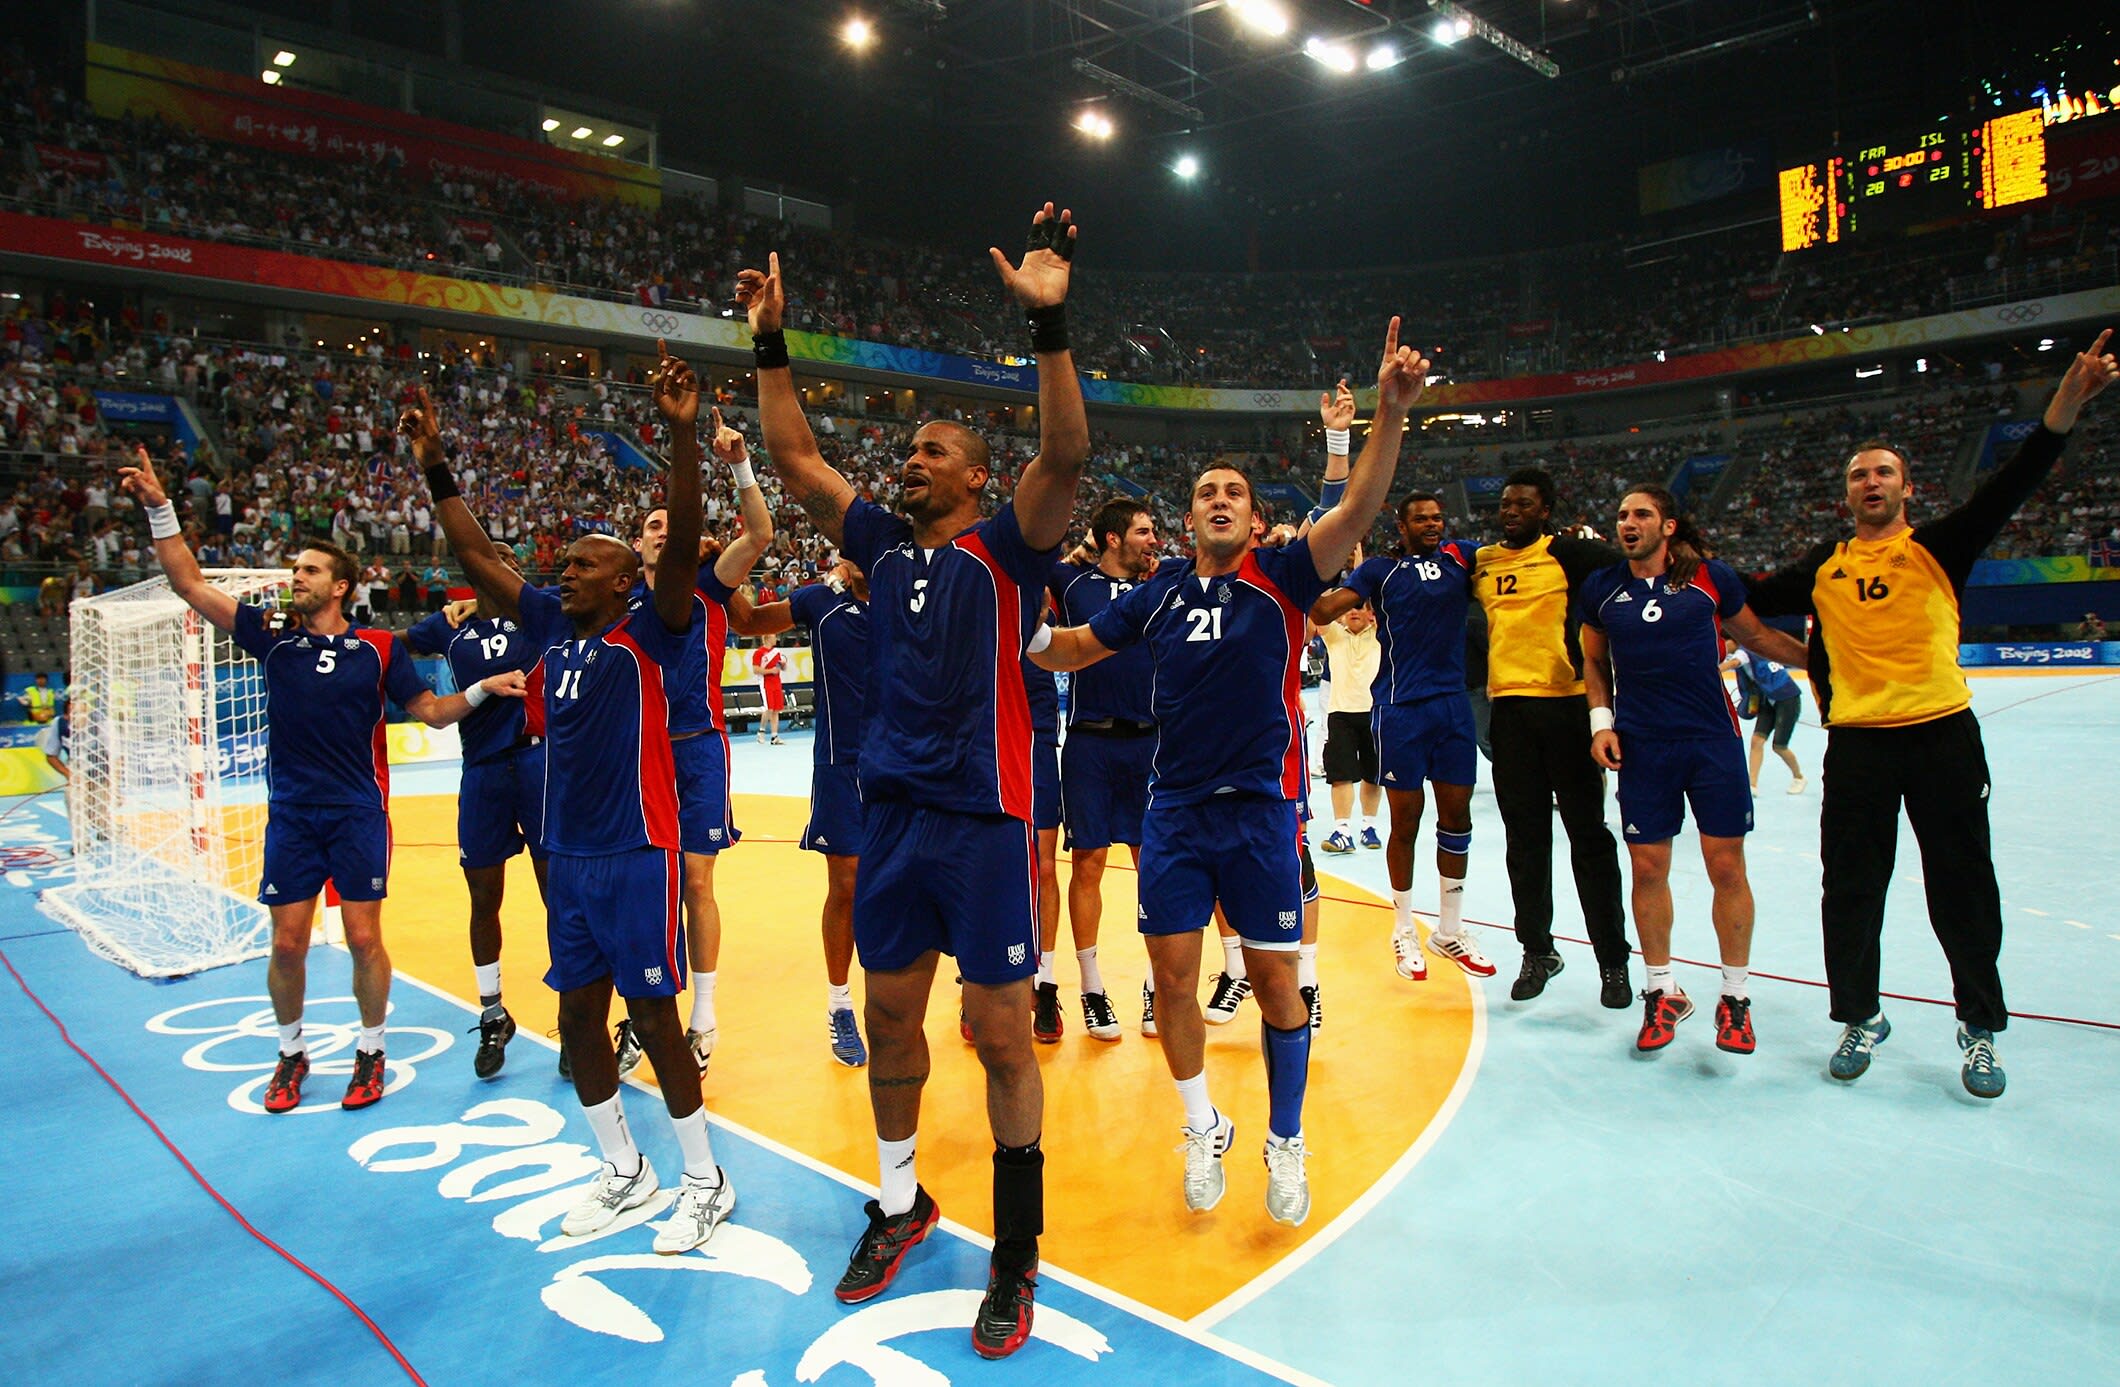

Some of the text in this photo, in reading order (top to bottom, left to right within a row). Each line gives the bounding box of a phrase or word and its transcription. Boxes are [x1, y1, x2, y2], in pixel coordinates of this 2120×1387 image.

[1919, 132, 1946, 148] ISL
[1859, 146, 1887, 162] FRA
[1883, 150, 1926, 173] 30:00
[1929, 166, 1950, 182] 23
[1865, 181, 1886, 197] 28
[78, 231, 193, 264] Beijing 2008
[1415, 560, 1442, 582] 18
[1495, 574, 1518, 596] 12
[1856, 575, 1889, 602] 16
[1641, 599, 1663, 623] 6
[1186, 606, 1222, 642] 21
[481, 633, 508, 660] 19
[1996, 646, 2093, 663] Beijing 2008
[316, 649, 337, 674] 5
